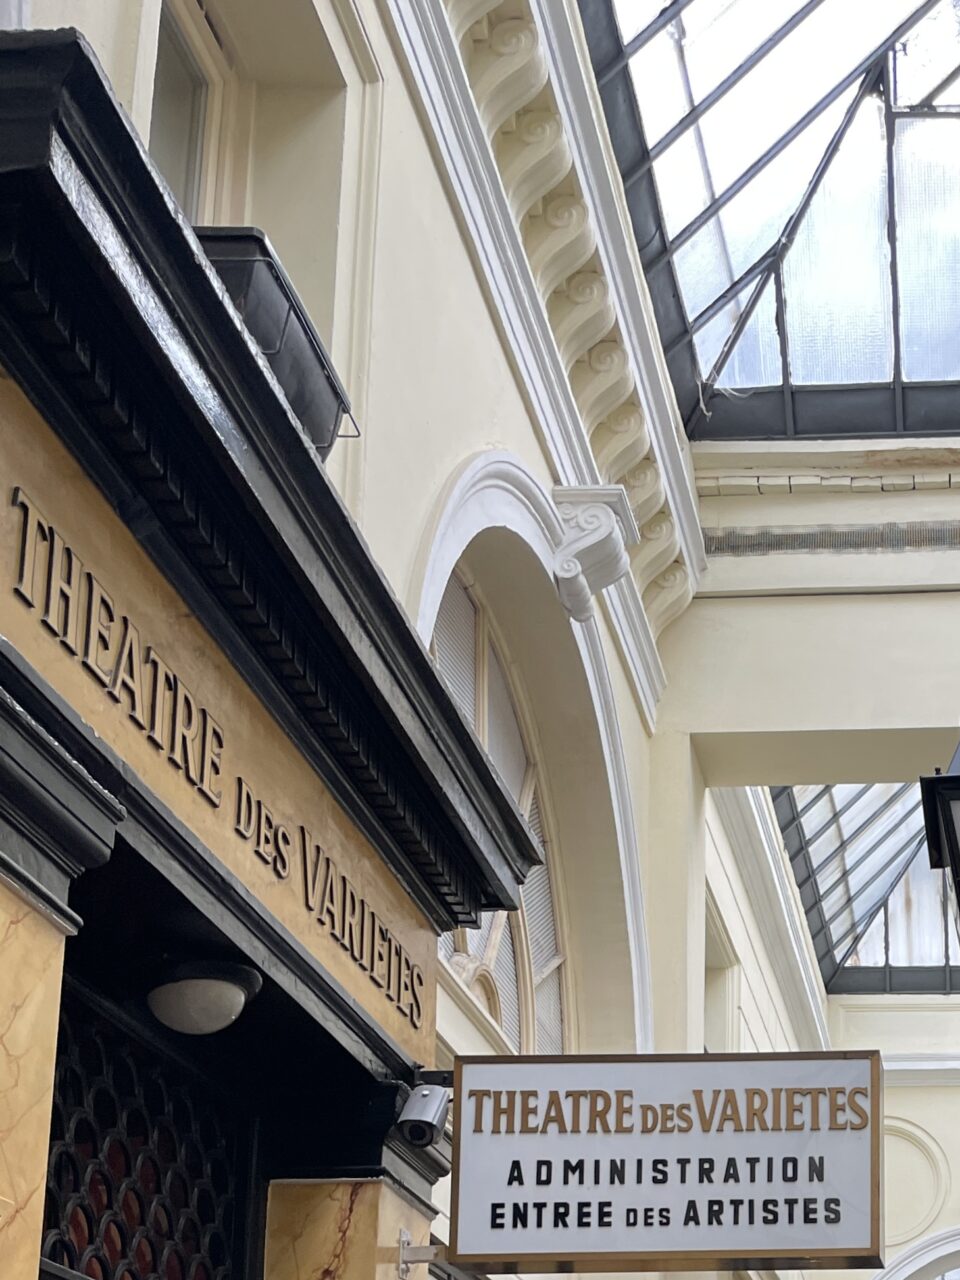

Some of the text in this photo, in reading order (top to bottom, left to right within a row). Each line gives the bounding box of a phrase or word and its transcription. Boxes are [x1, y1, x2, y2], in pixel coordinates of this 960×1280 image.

[12, 486, 424, 1030] THEATRE DES VARIETES
[467, 1086, 869, 1135] THEATRE DES VARIETES
[507, 1156, 825, 1186] ADMINISTRATION
[490, 1197, 842, 1229] ENTREE DES ARTISTES
